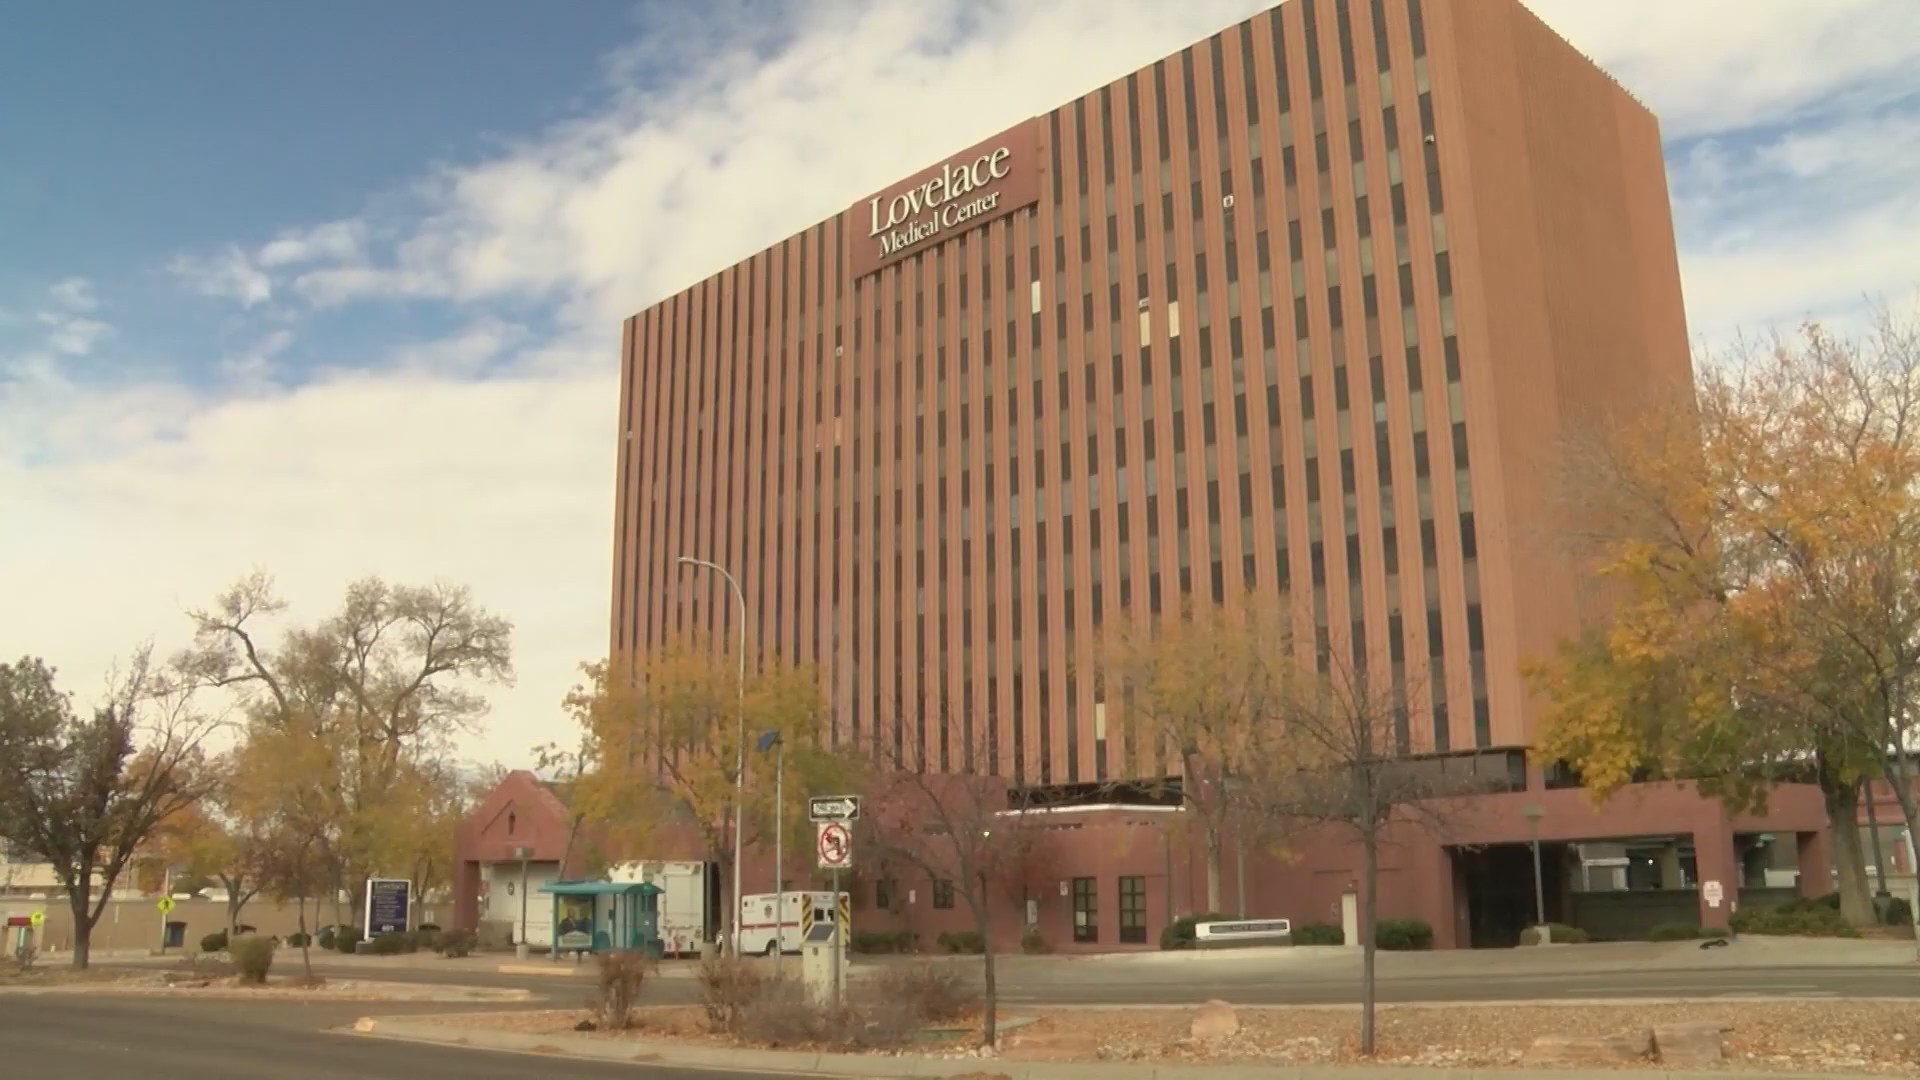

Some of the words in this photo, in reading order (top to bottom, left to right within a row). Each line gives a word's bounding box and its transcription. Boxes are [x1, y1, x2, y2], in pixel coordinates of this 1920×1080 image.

[868, 147, 1011, 238] Lovelace
[879, 211, 940, 258] Medical
[942, 191, 1000, 228] Center
